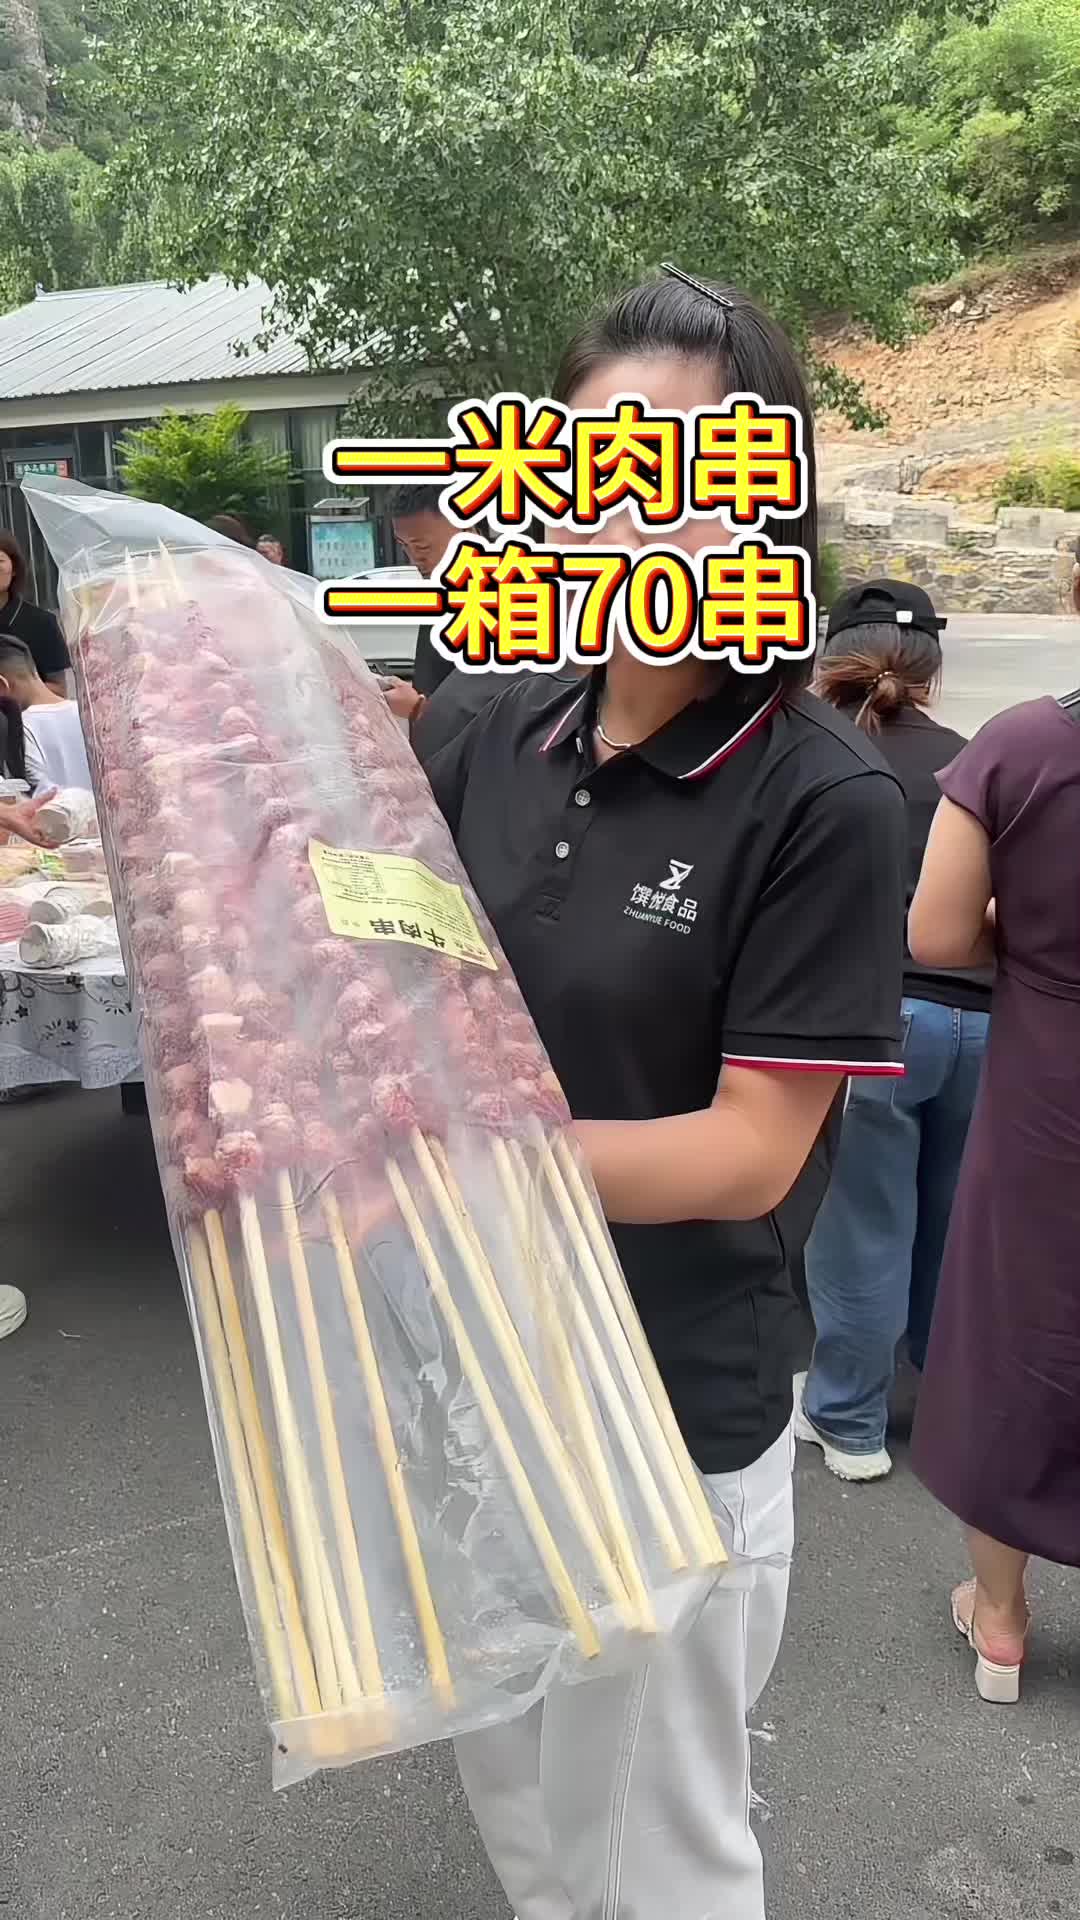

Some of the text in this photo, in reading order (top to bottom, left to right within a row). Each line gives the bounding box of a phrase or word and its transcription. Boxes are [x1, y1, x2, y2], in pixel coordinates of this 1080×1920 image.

[630, 883, 697, 921] 馔悦食品
[367, 917, 445, 948] 牛肉串
[623, 905, 691, 934] ZHUANYUE FOOD
